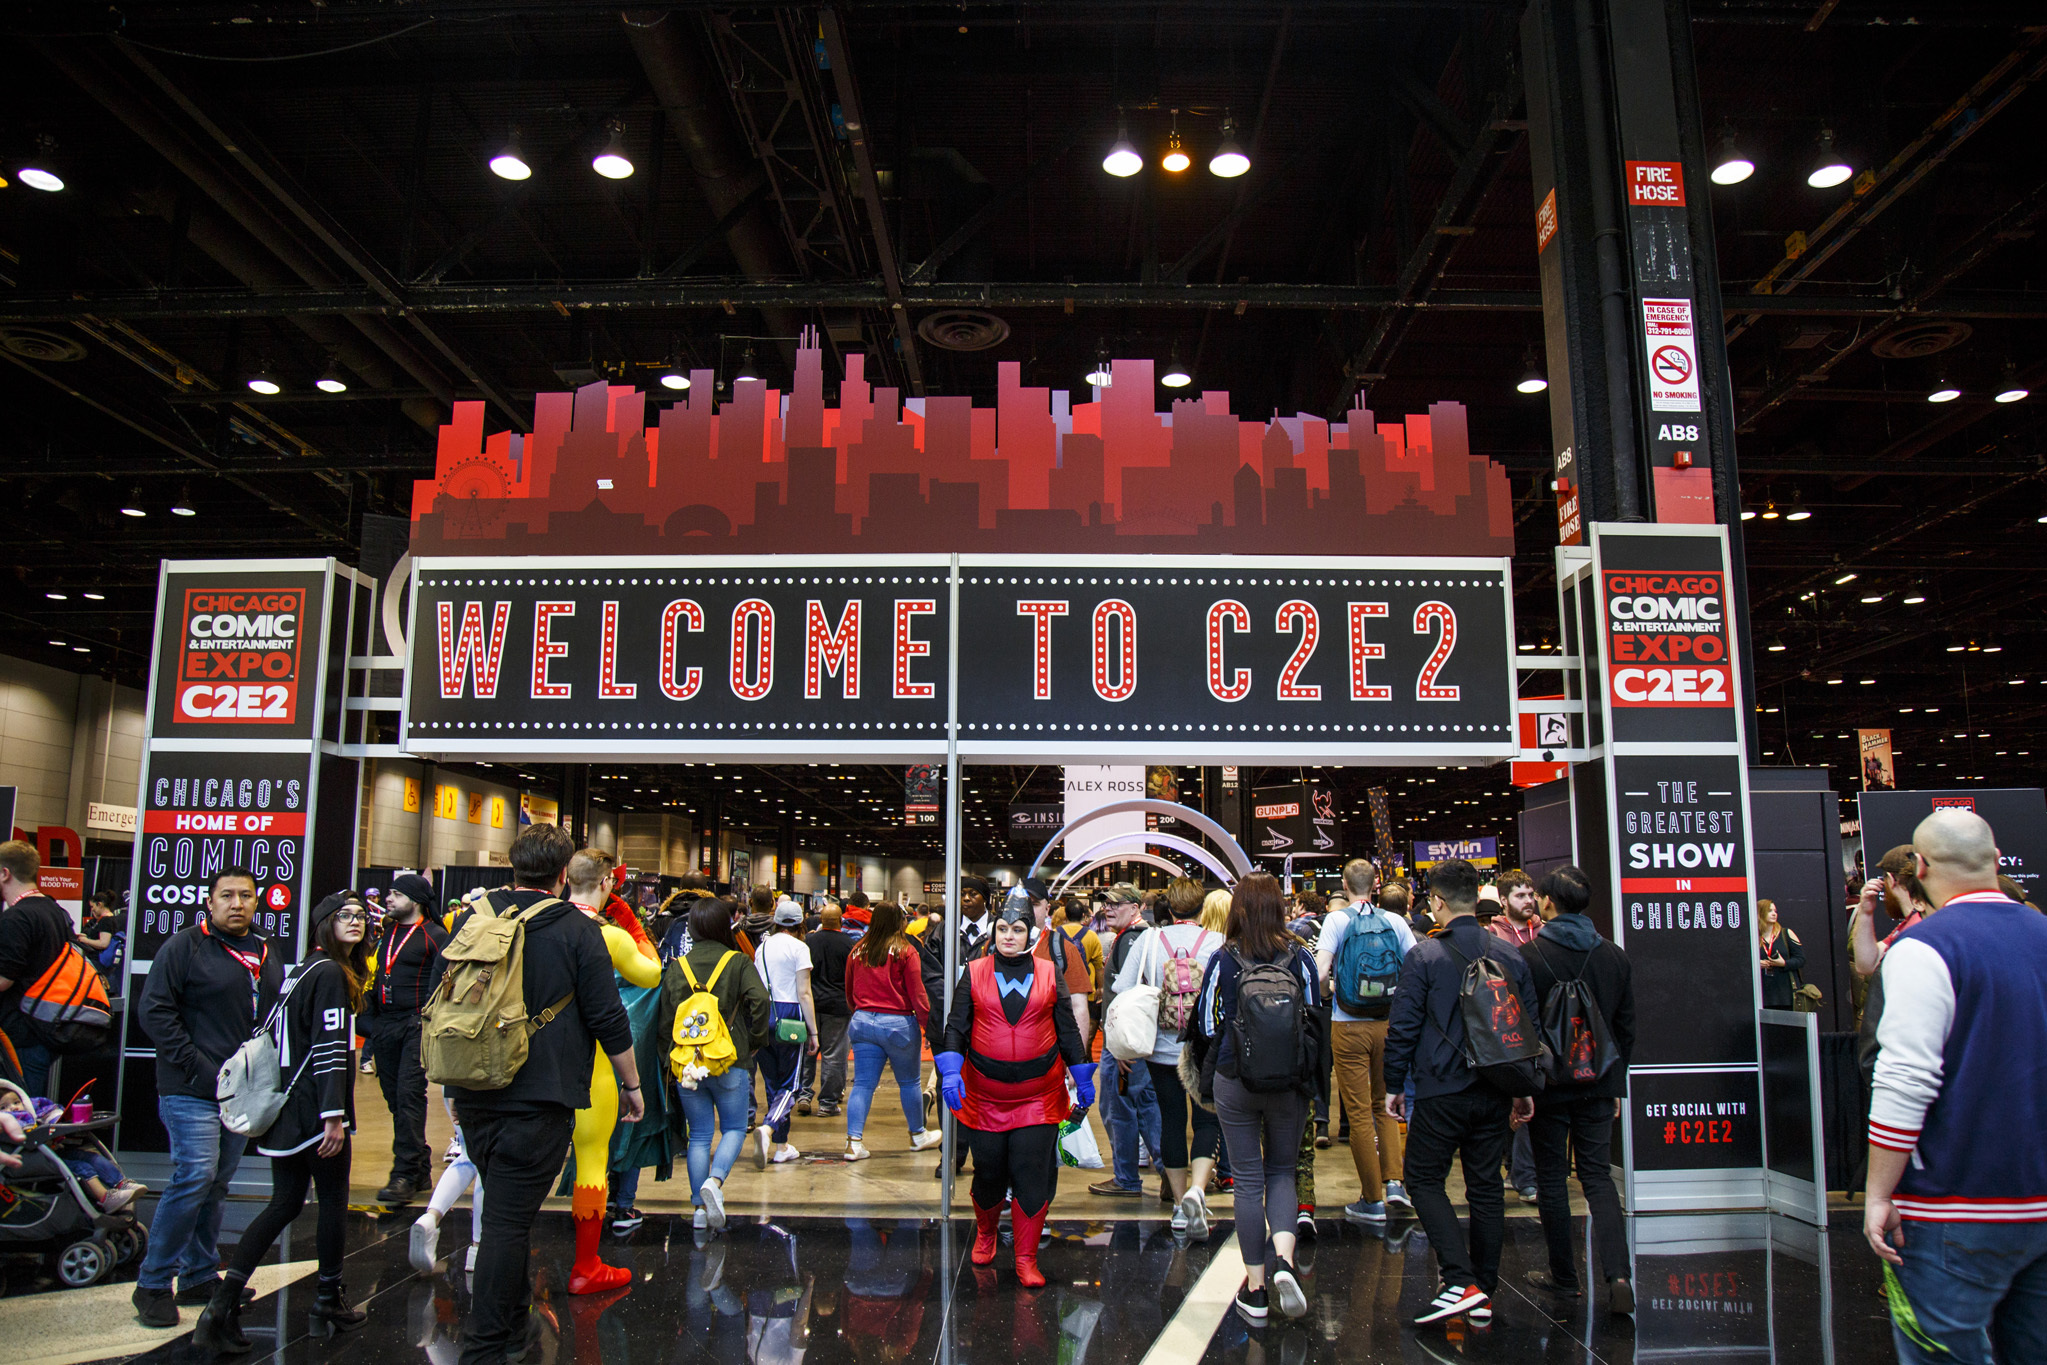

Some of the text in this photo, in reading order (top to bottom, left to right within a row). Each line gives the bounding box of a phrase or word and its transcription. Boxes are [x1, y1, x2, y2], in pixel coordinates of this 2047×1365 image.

[1636, 166, 1672, 182] FIRE
[1635, 184, 1679, 200] HOSE
[1538, 199, 1552, 228] FIRE
[1539, 214, 1555, 246] HOSE
[1646, 313, 1689, 321] EMERGENCY
[1647, 306, 1655, 314] IN
[1656, 306, 1675, 314] CASE
[1653, 391, 1698, 399] NO SMOKING
[1658, 424, 1699, 441] AB8
[1557, 446, 1572, 473] AB8
[1559, 495, 1578, 524] FIRE
[1560, 514, 1580, 543] HOSE
[1609, 576, 1718, 594] CHICAGO
[192, 595, 297, 612] CHICAGO
[1610, 596, 1720, 620] COMIC
[190, 614, 295, 638] COMIC
[1612, 621, 1721, 632] & ENTERTAINMENT
[188, 639, 294, 649] & ENTERTAINMENT
[437, 598, 1460, 702] WELCOME TO C2E2
[1613, 634, 1724, 662] EXPO
[186, 651, 292, 678] EXPO
[1613, 668, 1726, 702] C2E2
[181, 685, 289, 718] C2E2
[1862, 734, 1880, 743] BLACK
[1862, 737, 1888, 752] HAMMER
[155, 778, 300, 808] CHICAGO'S
[1067, 781, 1144, 792] ALEX ROSS
[1657, 781, 1698, 804] THE
[920, 814, 935, 822] 100
[1034, 812, 1064, 823] INSI
[1256, 804, 1298, 816] GUNPLA
[176, 814, 273, 831] HOME OF
[1626, 811, 1733, 834] GREATEST
[1428, 840, 1482, 858] stylin
[1629, 843, 1735, 869] SHOW
[149, 836, 296, 881] COMICS
[40, 875, 58, 883] What's
[1676, 880, 1691, 891] IN
[271, 888, 286, 906] &
[144, 909, 184, 934] POP
[1631, 901, 1741, 930] CHICAGO
[322, 1007, 345, 1031] 91
[1646, 1102, 1746, 1117] GET SOCIAL WITH
[1663, 1120, 1733, 1144] #C2E2
